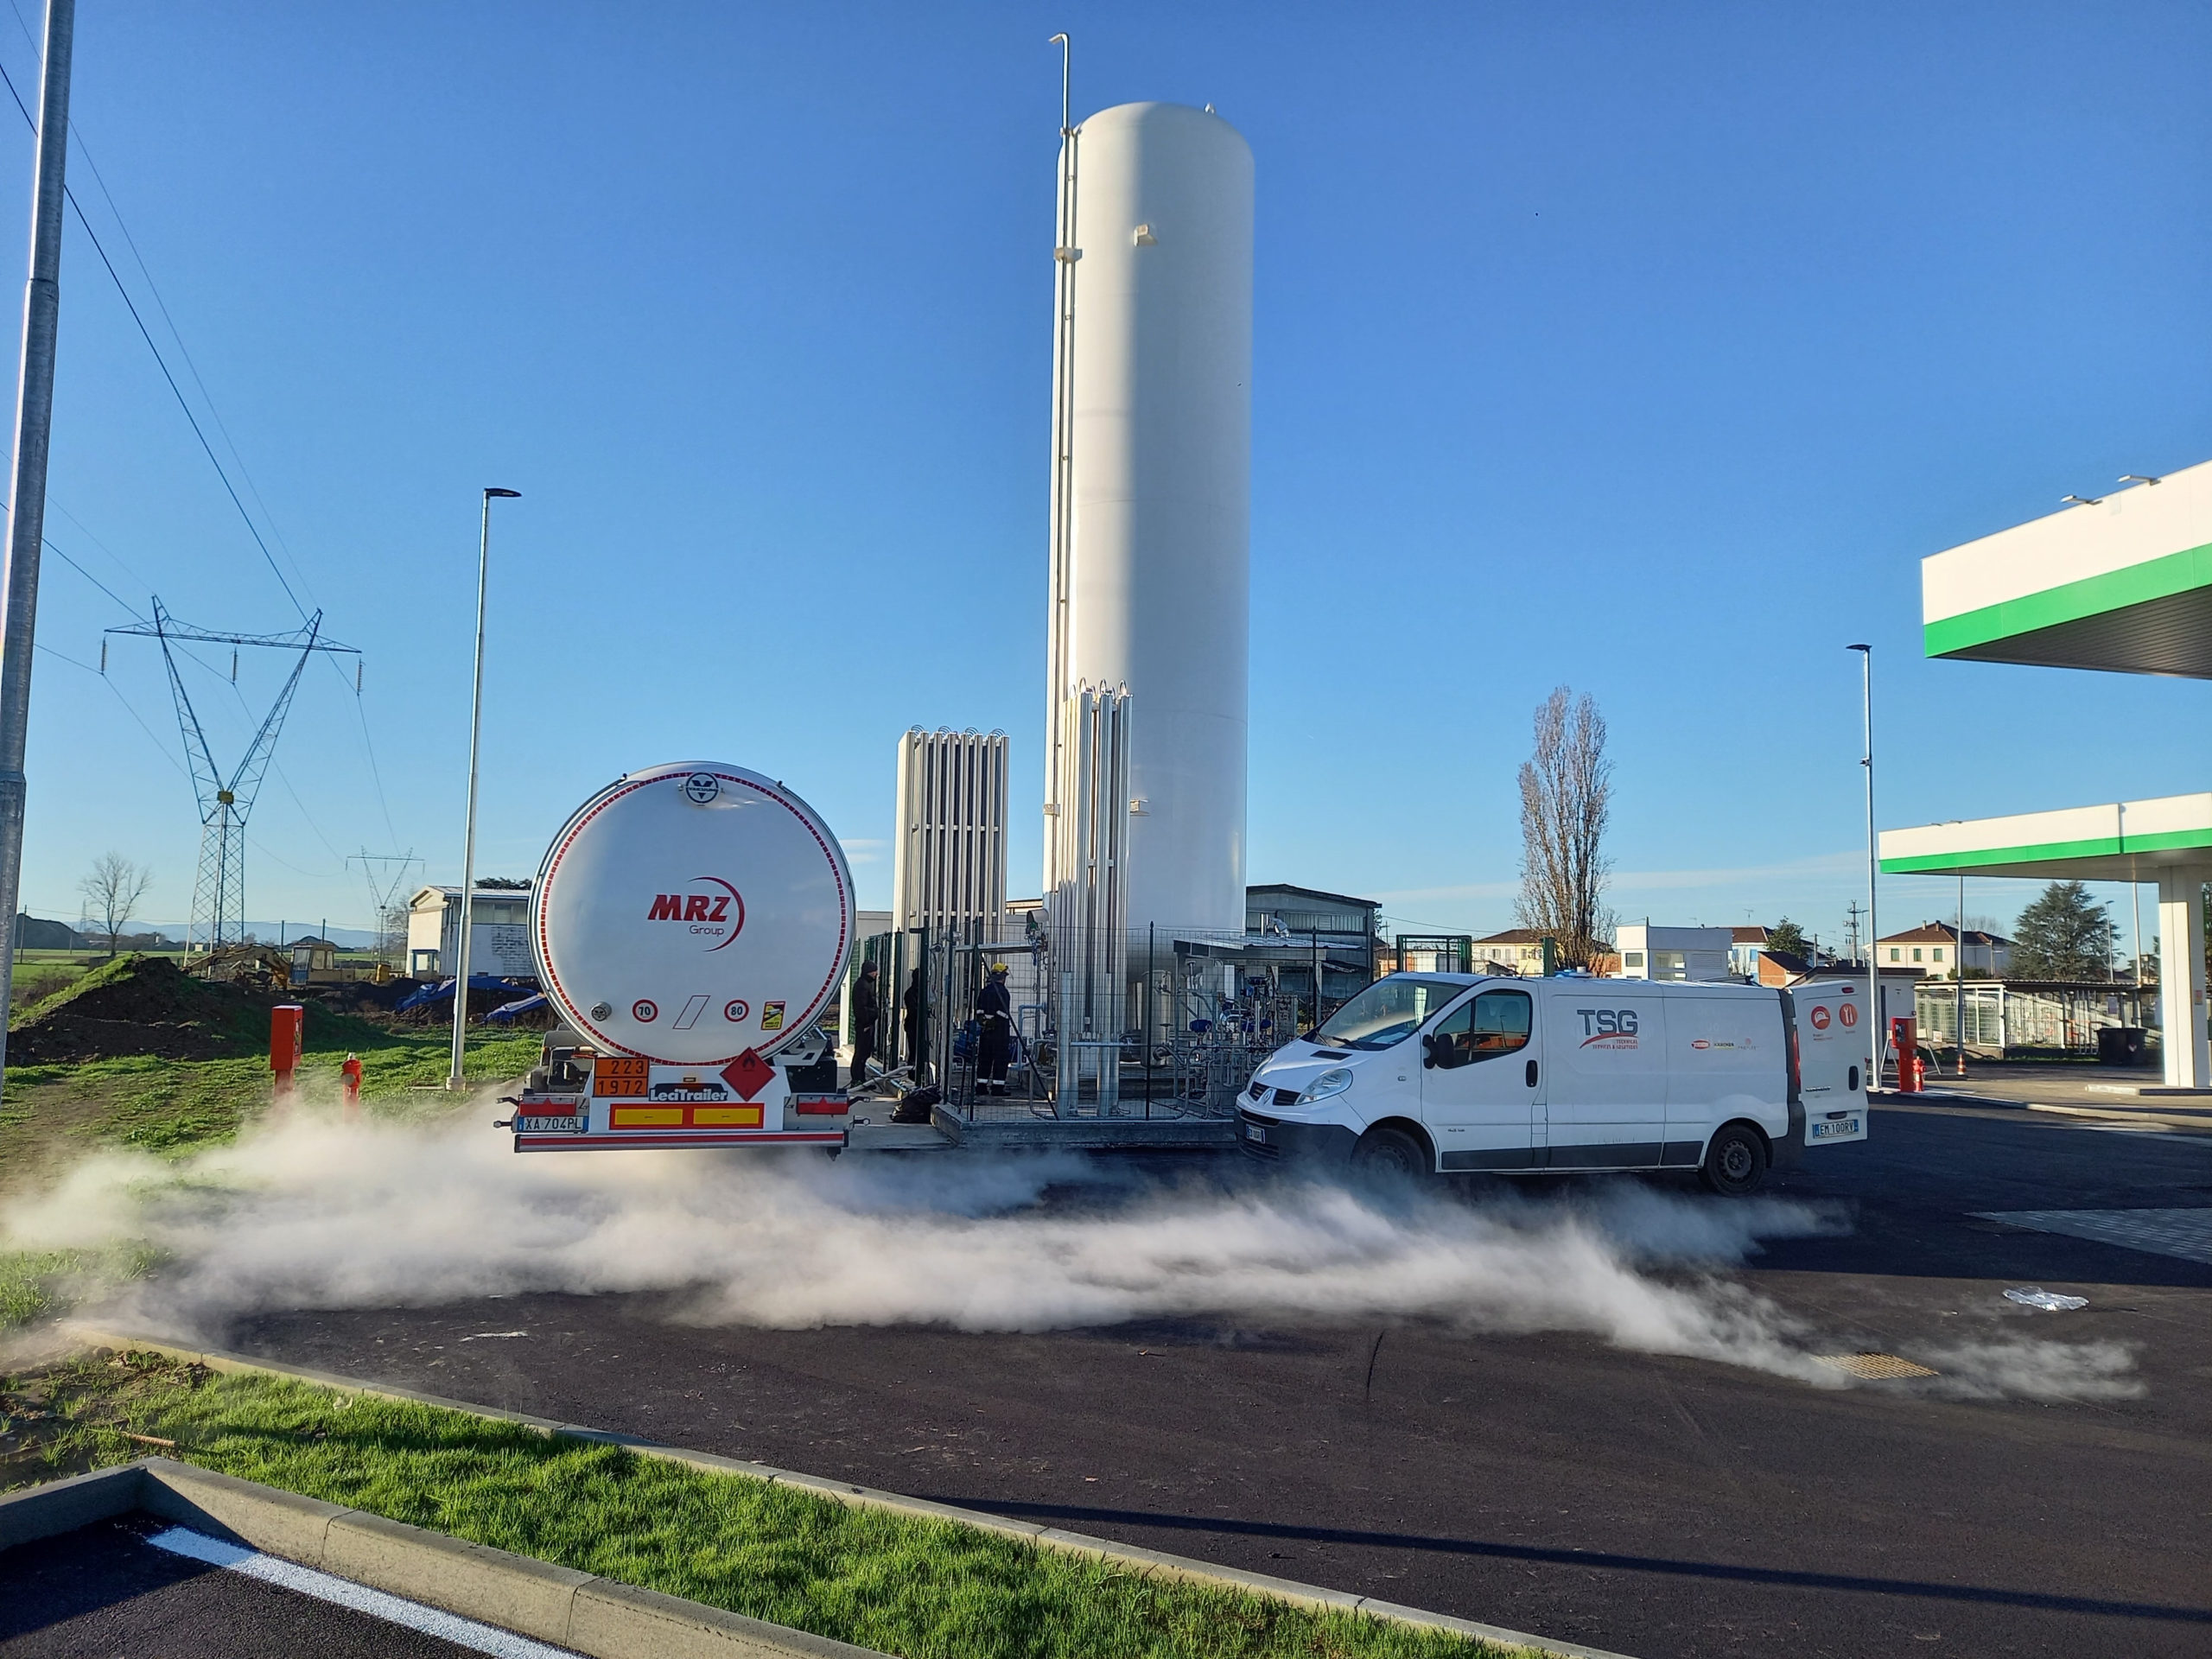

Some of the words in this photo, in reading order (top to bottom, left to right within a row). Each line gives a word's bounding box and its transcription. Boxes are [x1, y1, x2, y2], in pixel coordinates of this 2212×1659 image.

[647, 894, 731, 922] MRZ
[690, 925, 725, 937] Group
[639, 1006, 651, 1016] 70
[731, 1006, 743, 1016] 80
[1577, 1009, 1638, 1035] TSG
[611, 1060, 644, 1075] 223
[599, 1080, 643, 1095] 1972
[650, 1088, 728, 1102] LeciTrailer
[525, 1118, 540, 1130] XA
[544, 1118, 582, 1130] 704PL
